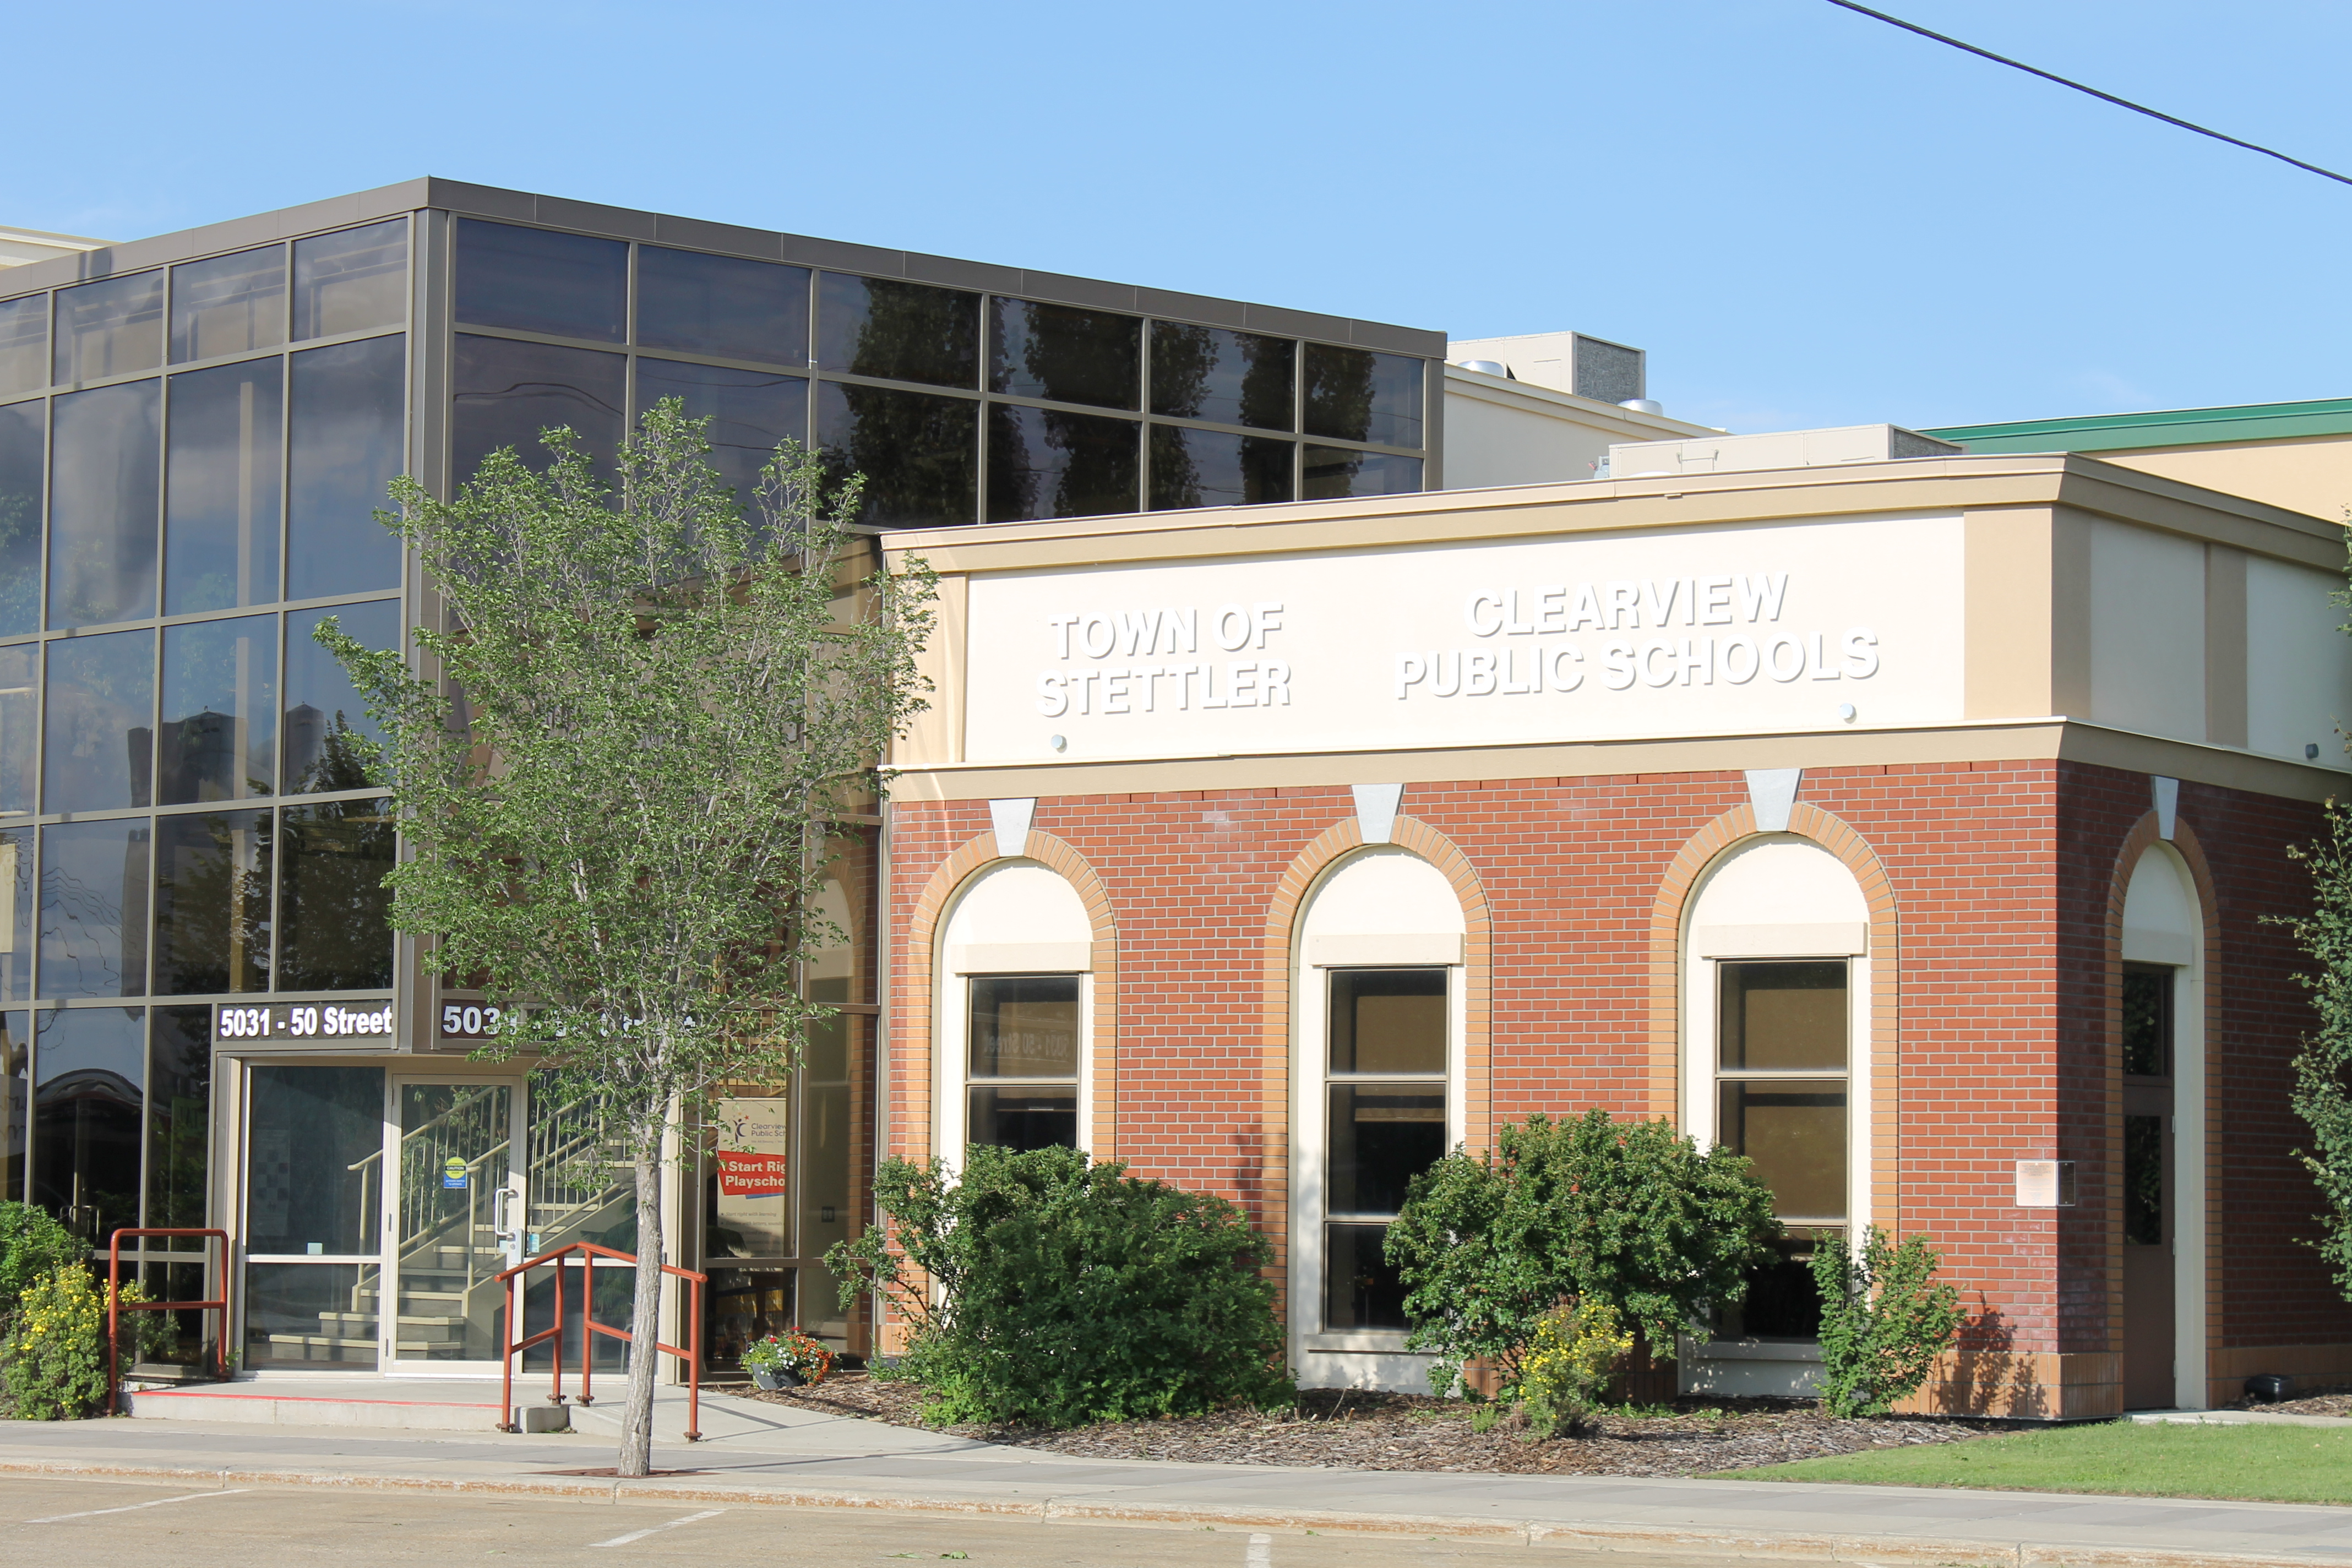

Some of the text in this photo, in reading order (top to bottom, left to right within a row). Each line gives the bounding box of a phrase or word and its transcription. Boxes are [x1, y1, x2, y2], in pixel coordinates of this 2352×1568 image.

[1048, 600, 1284, 660] TOWN OF
[1463, 571, 1789, 638] CLEARVIEW
[1035, 658, 1292, 718] STETTLER
[1393, 627, 1880, 701] PUBLIC SCHOOLS
[220, 1008, 271, 1037] 5031
[290, 1006, 318, 1037] 50
[323, 1005, 393, 1036] Street
[728, 1161, 763, 1172] Start
